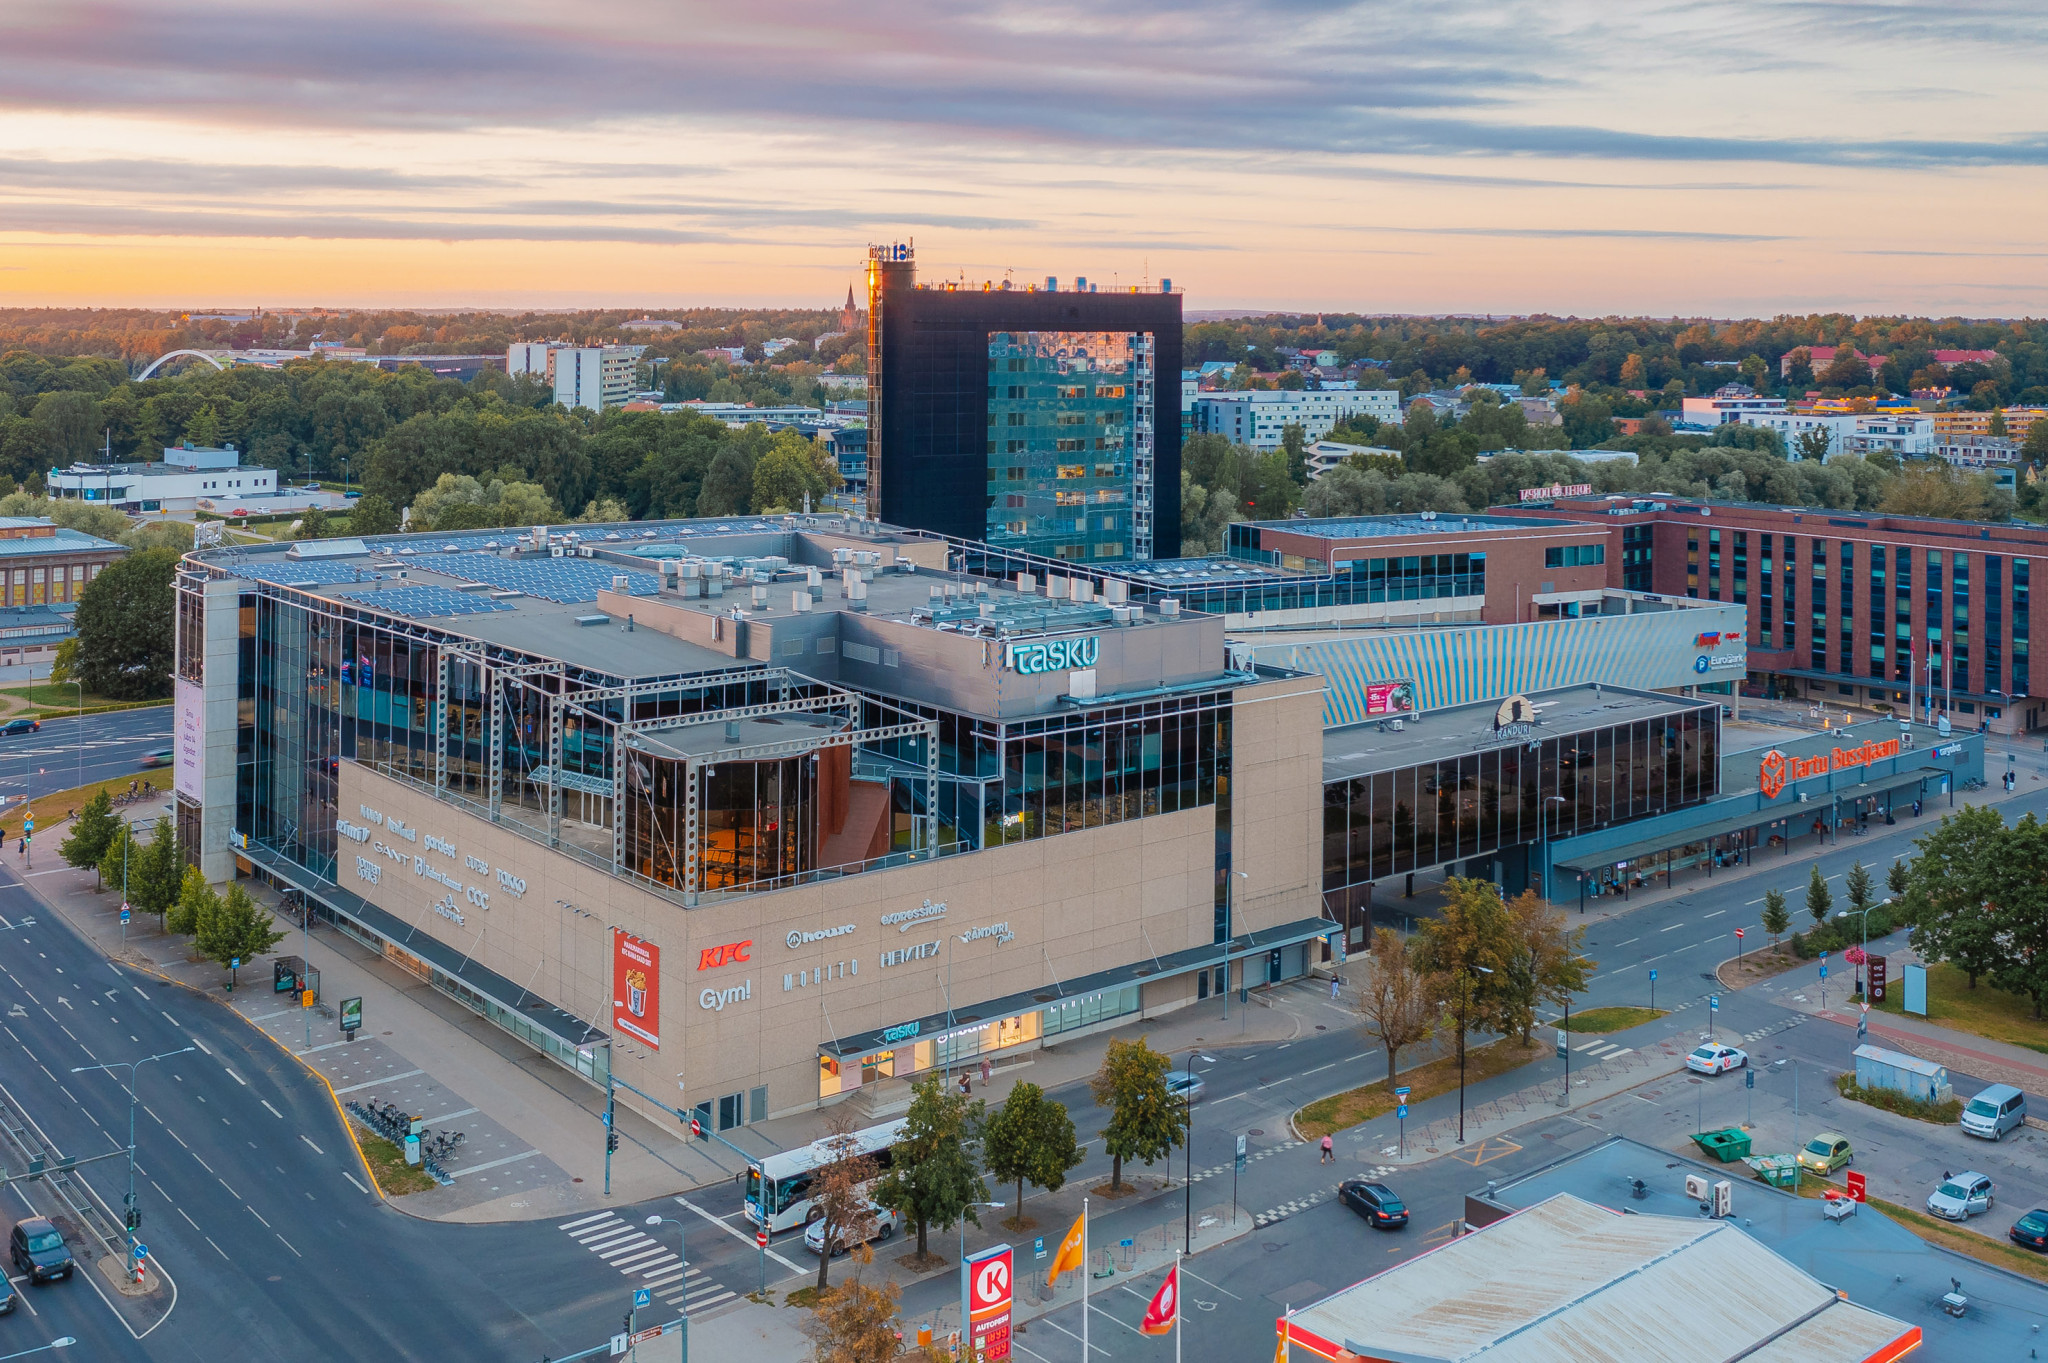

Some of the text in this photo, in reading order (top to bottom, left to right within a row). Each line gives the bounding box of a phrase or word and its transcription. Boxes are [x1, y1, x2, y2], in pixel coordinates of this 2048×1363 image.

[1789, 739, 1900, 780] Tartu Bussijaam
[373, 841, 411, 866] GANT
[466, 886, 490, 911] CCC
[880, 898, 948, 926] expressions
[697, 939, 753, 971] KFC
[783, 958, 858, 992] MOHITO
[699, 979, 751, 1011] Gym!
[975, 1313, 1009, 1332] AUTOPESU
